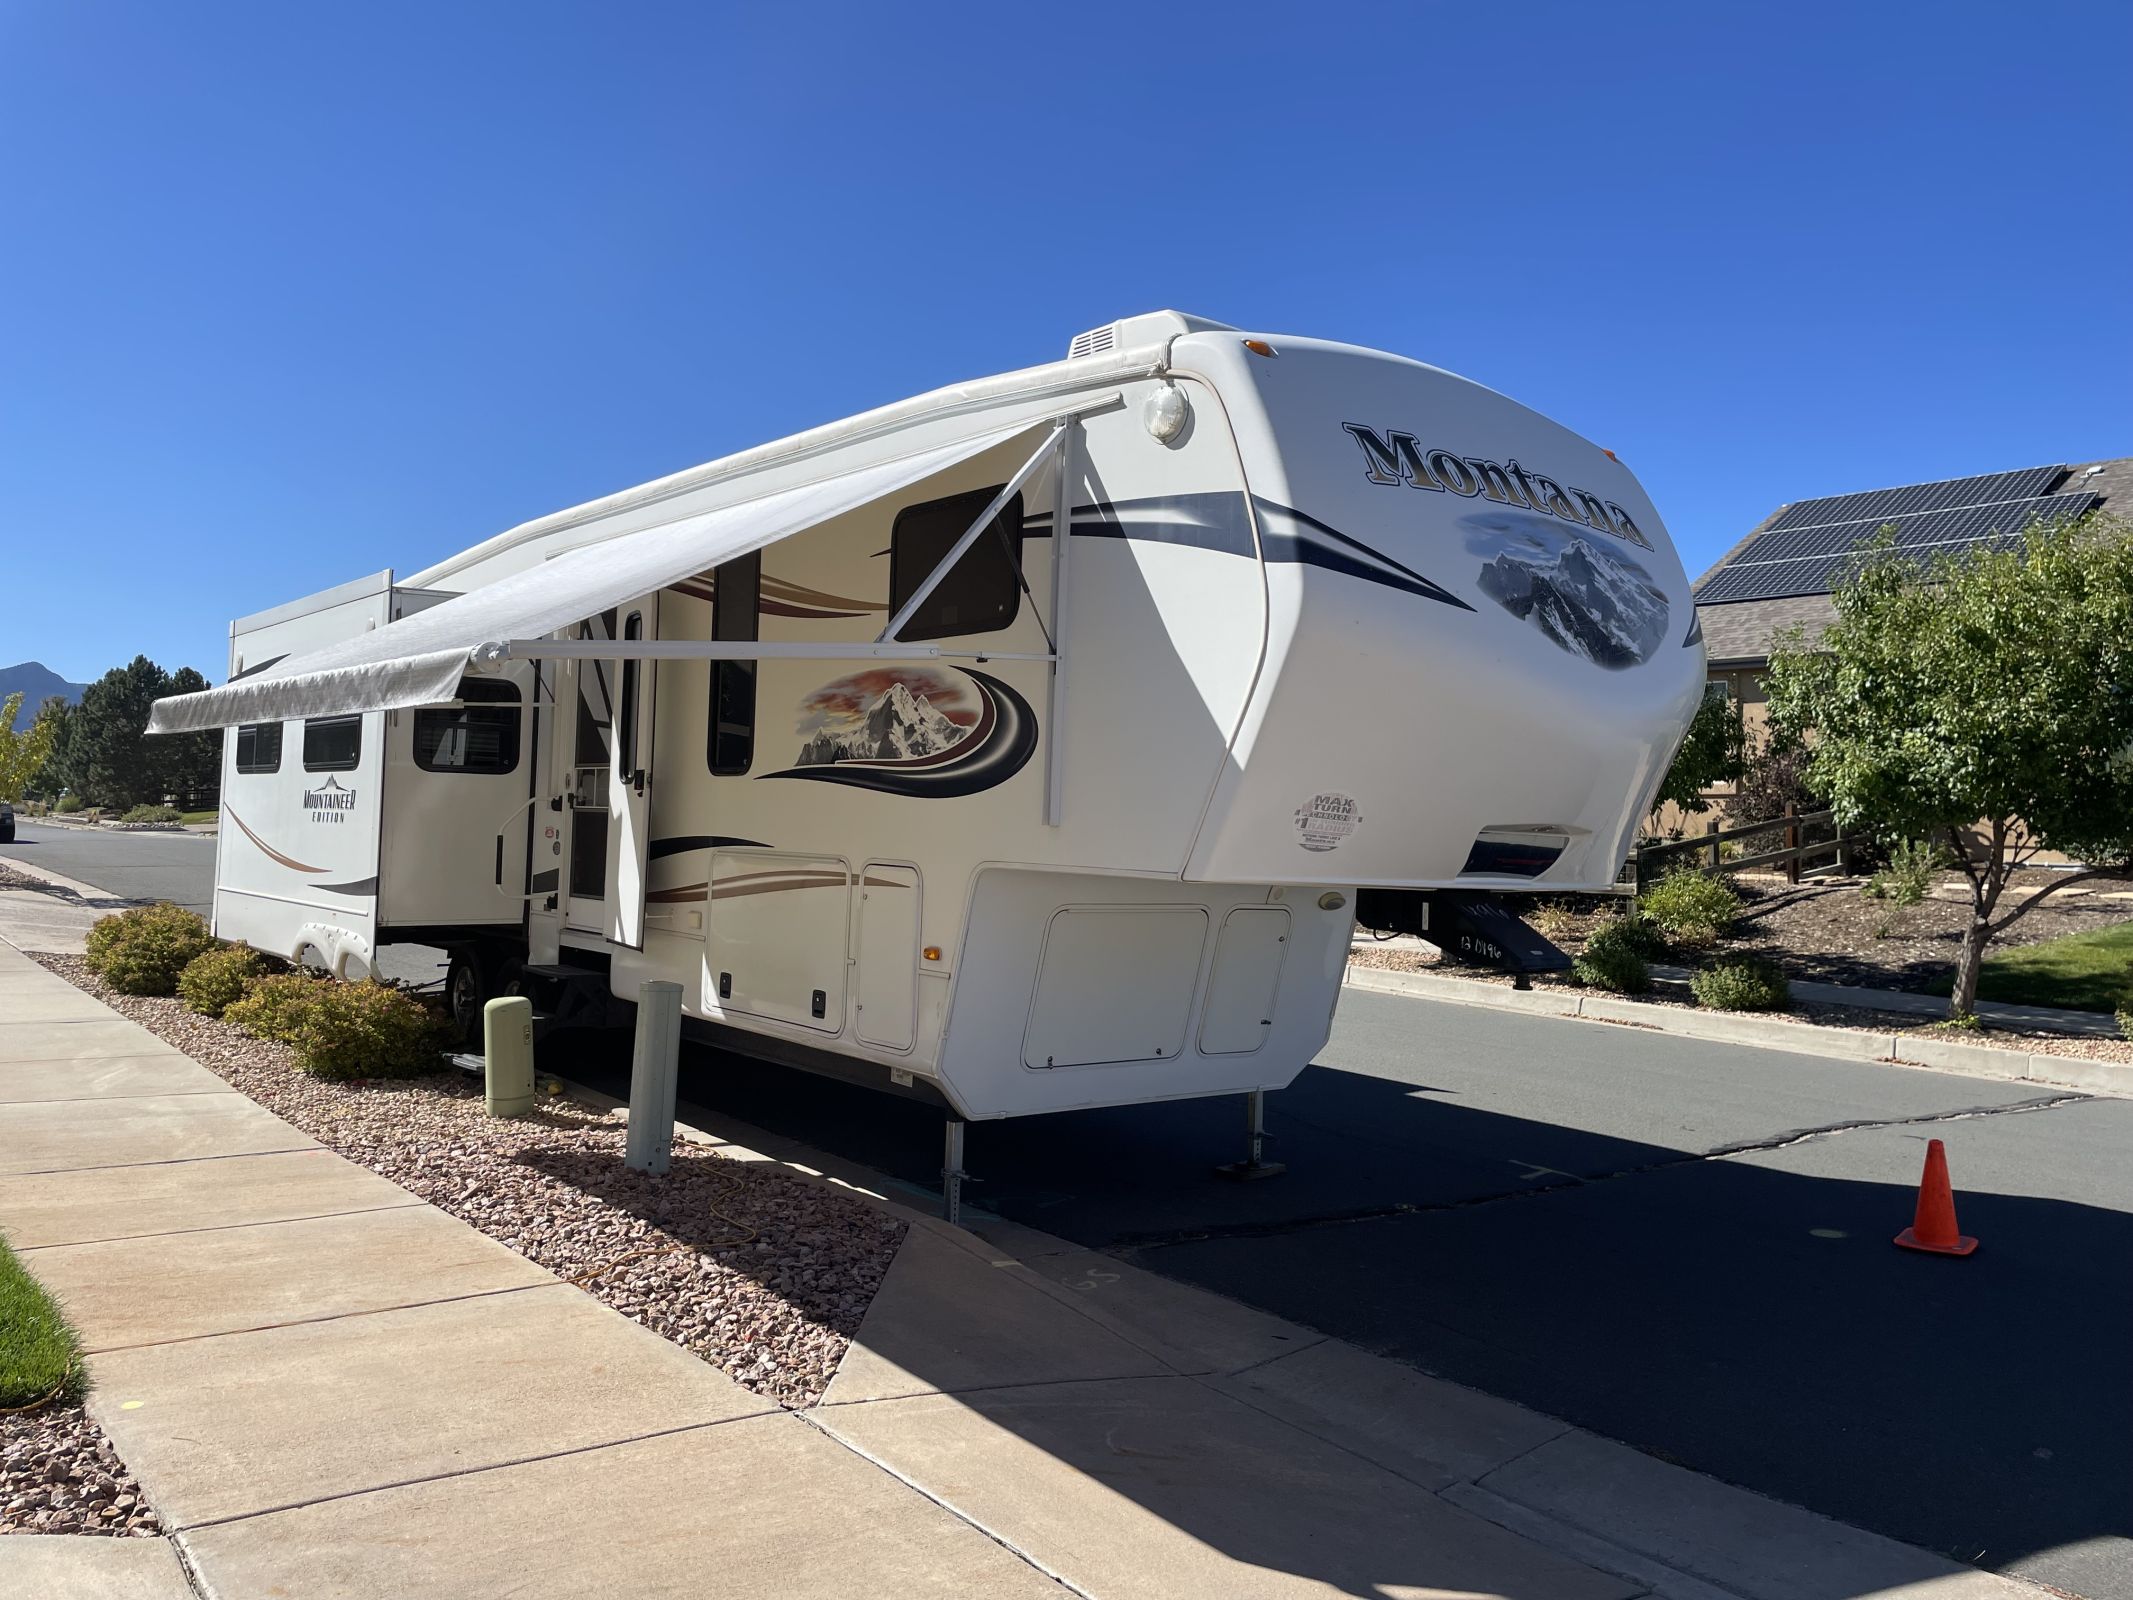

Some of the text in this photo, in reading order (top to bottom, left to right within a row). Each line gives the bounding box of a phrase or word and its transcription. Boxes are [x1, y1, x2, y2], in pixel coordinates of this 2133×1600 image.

[1341, 421, 1654, 552] Montana
[303, 790, 356, 810] MOUNTAINEER
[1314, 795, 1354, 807] MAX
[1314, 804, 1352, 814] TURN
[312, 811, 345, 824] EDITION
